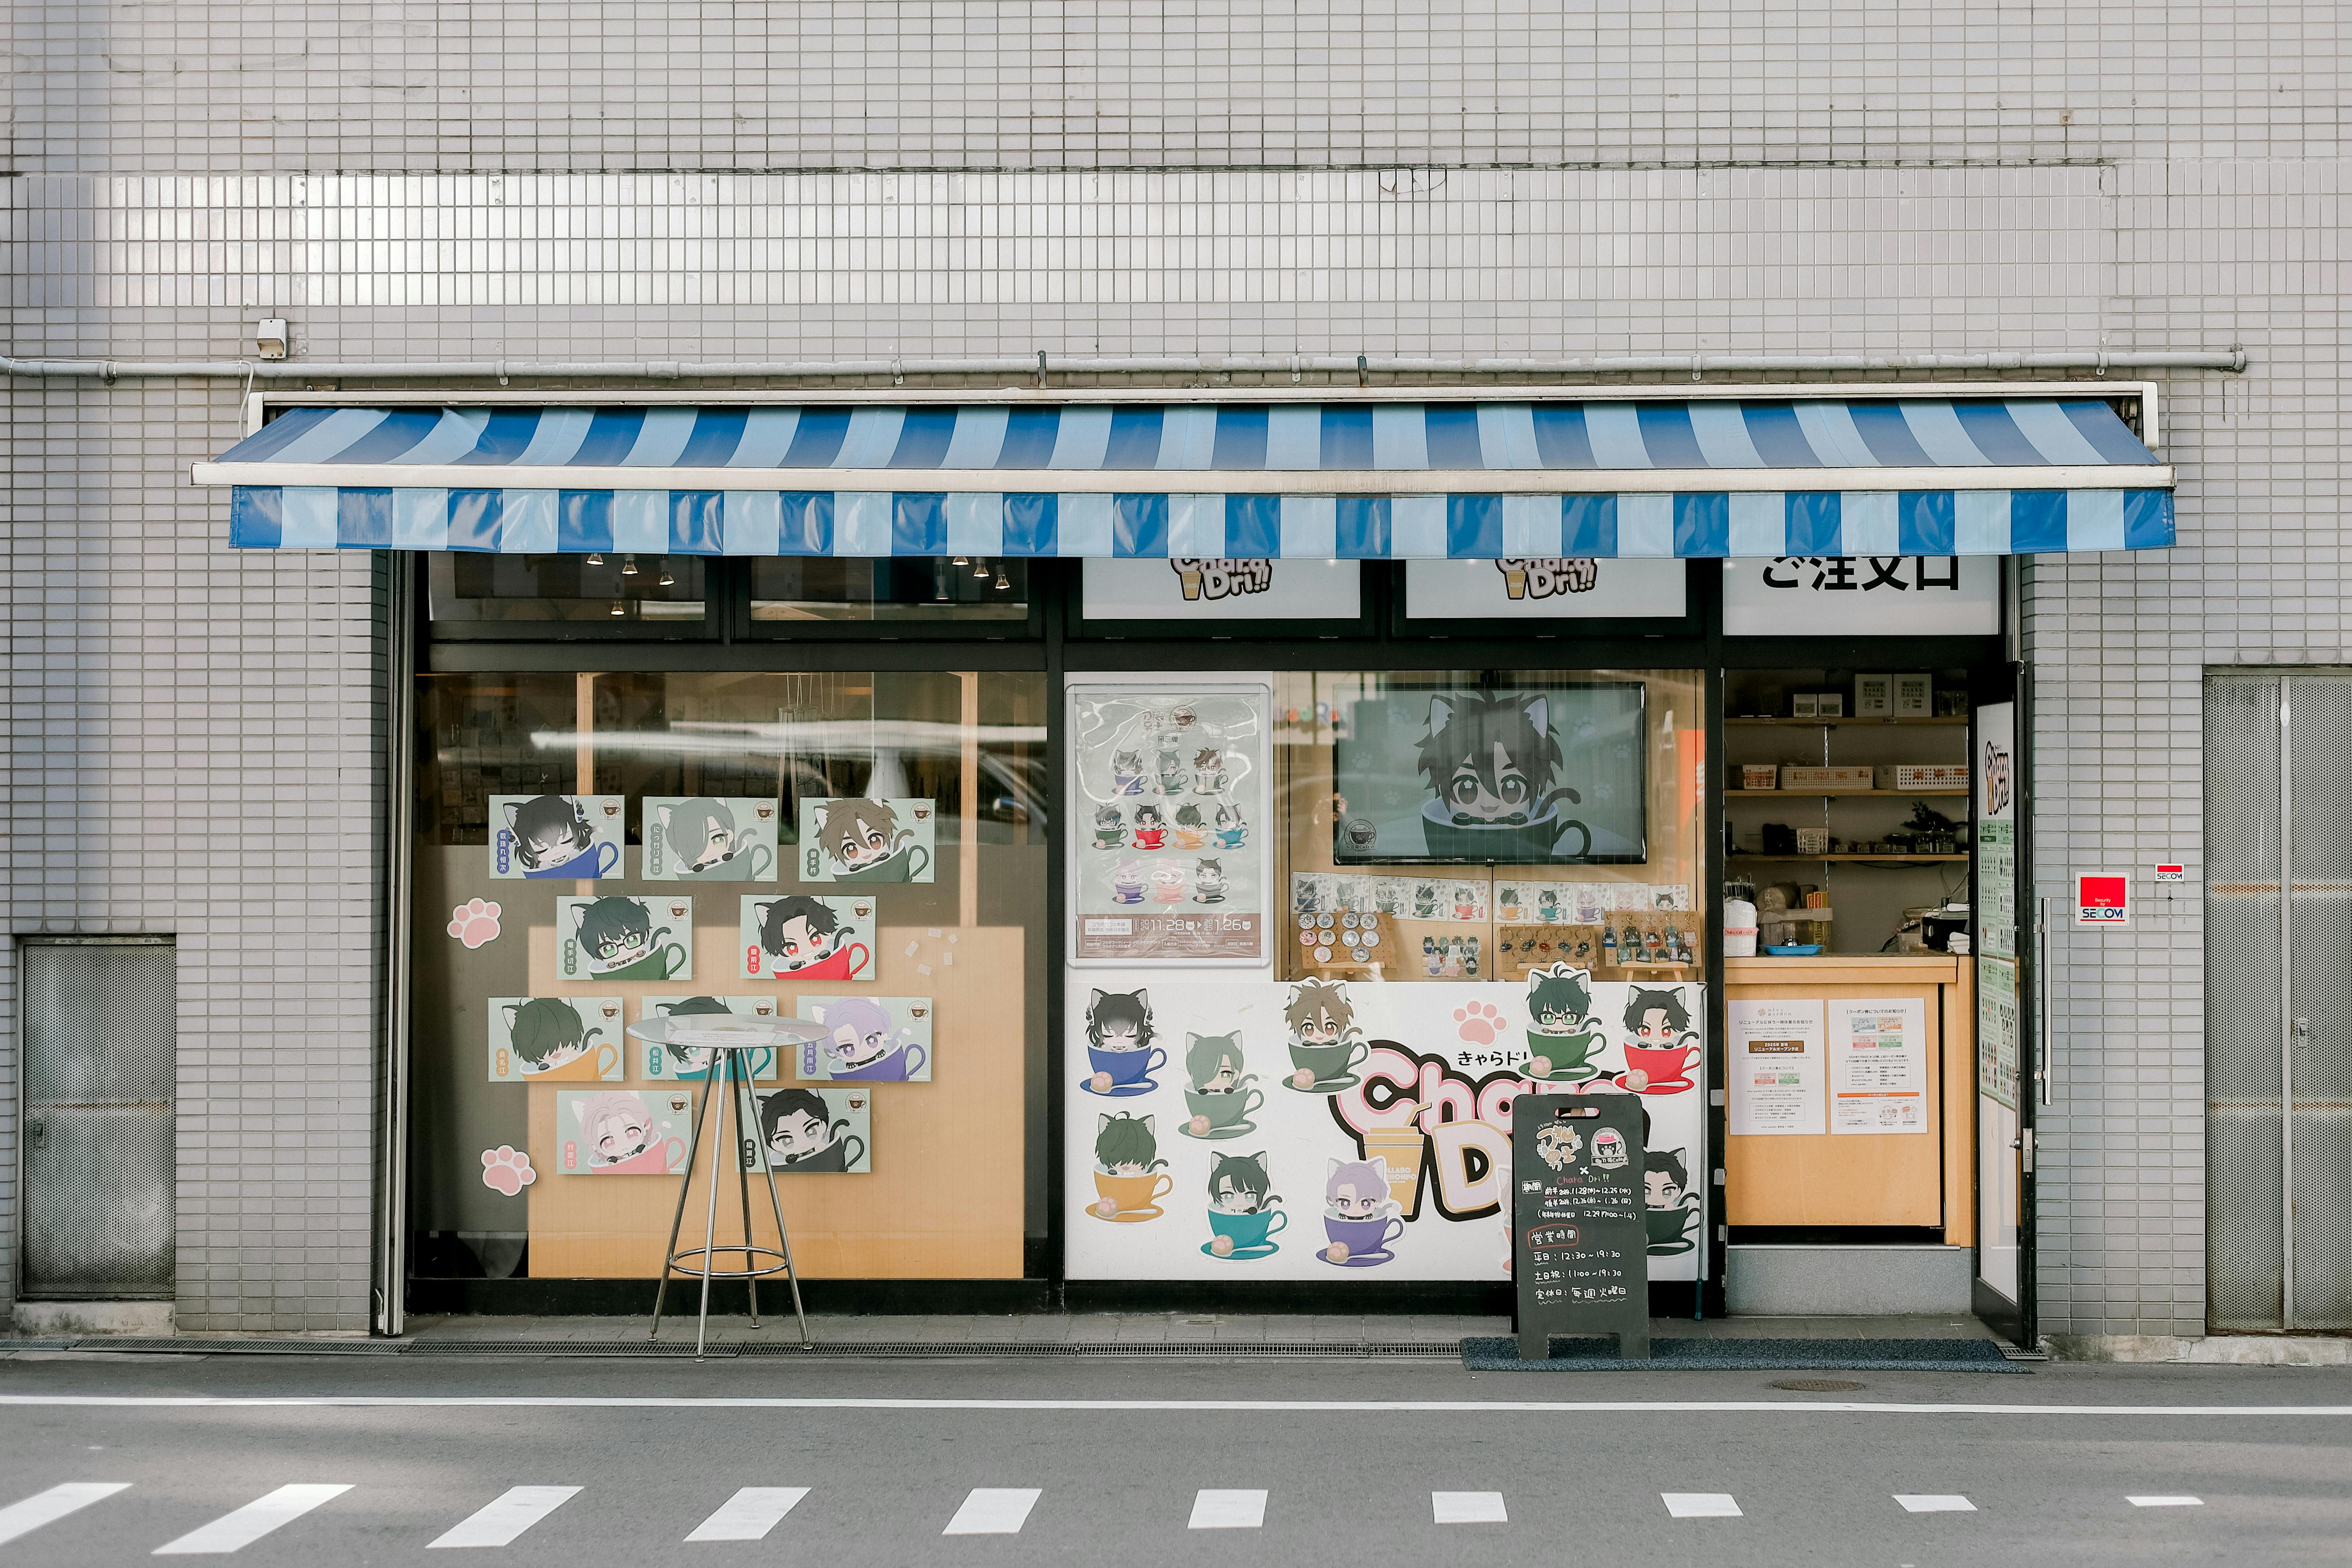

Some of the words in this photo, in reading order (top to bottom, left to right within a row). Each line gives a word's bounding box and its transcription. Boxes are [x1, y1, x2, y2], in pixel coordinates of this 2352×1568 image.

[1203, 566, 1270, 597] Dri!!
[1528, 564, 1595, 597] Dri!!
[2082, 908, 2123, 918] SECOM
[1458, 1051, 1527, 1066] きゃらド
[1523, 1181, 1541, 1193] 期間
[1557, 1176, 1583, 1186] Chara
[1532, 1229, 1576, 1245] 営業時間
